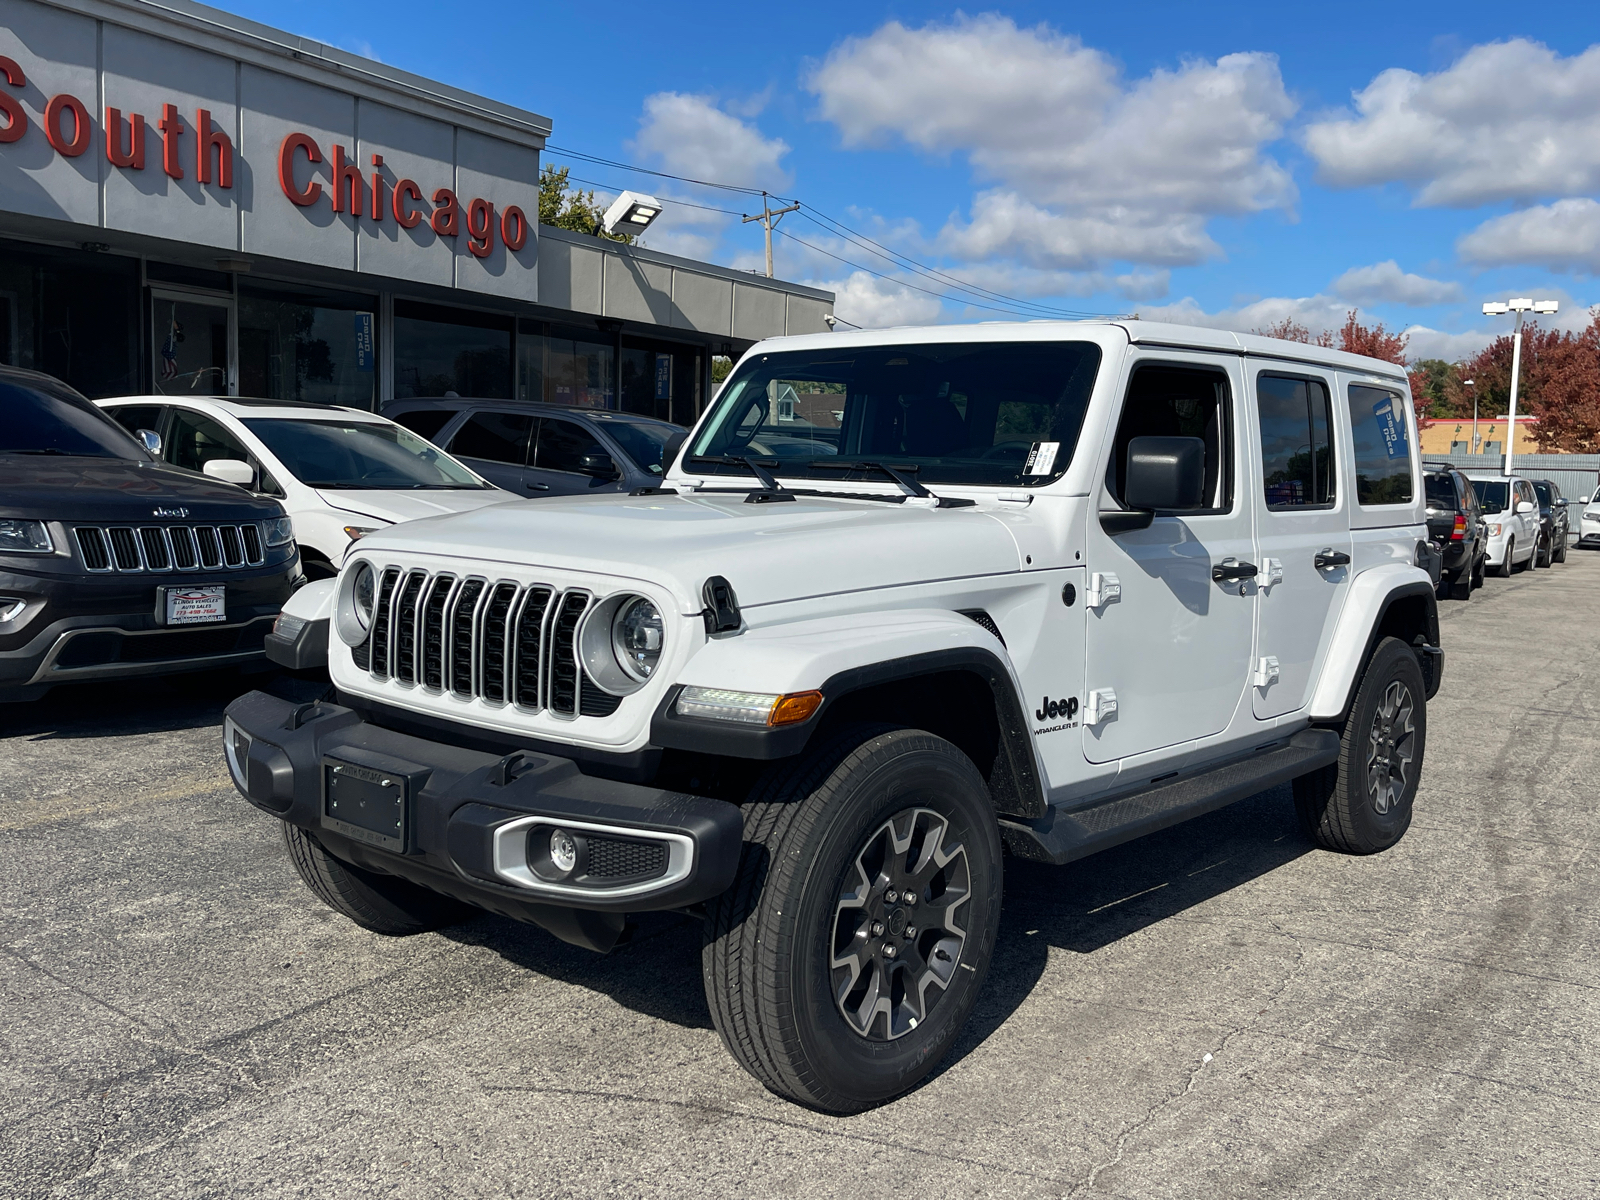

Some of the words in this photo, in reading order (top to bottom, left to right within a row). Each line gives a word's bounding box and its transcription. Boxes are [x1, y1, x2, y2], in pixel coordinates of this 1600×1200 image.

[0, 55, 233, 189] South
[278, 132, 528, 258] Chicago
[153, 506, 190, 518] Jeep
[1036, 696, 1078, 720] Jeep
[1034, 723, 1071, 735] WRANGLER
